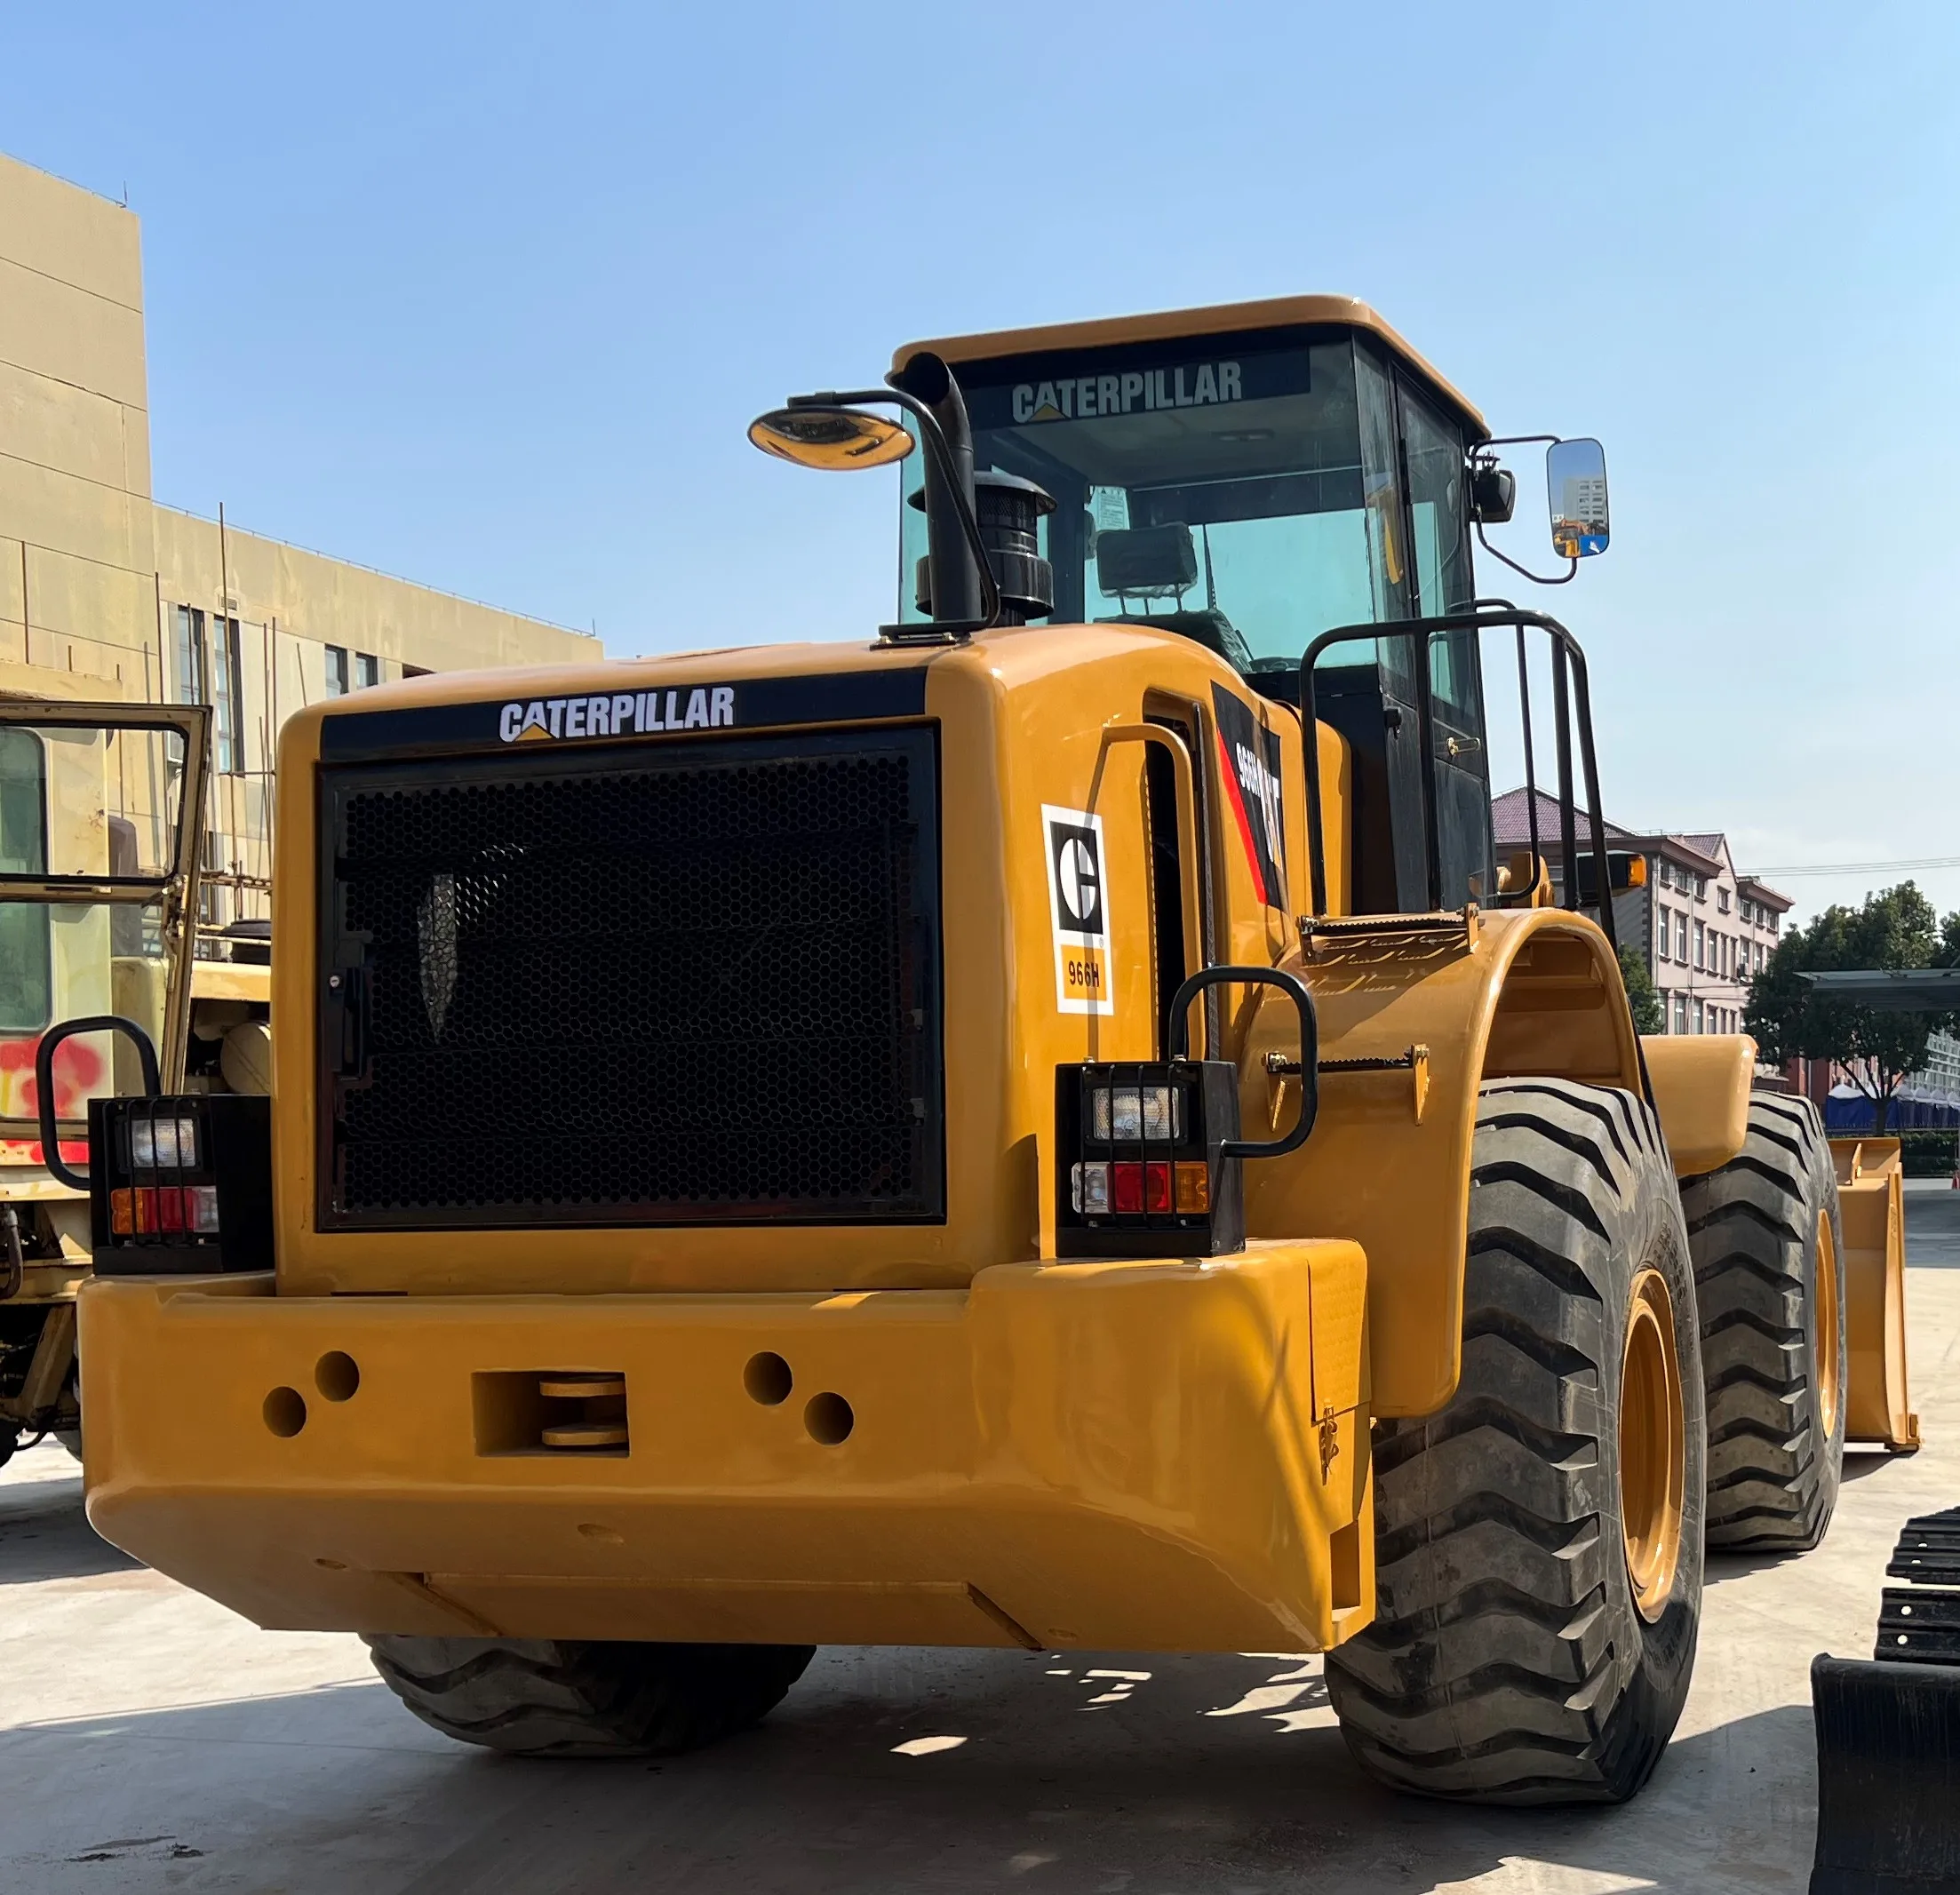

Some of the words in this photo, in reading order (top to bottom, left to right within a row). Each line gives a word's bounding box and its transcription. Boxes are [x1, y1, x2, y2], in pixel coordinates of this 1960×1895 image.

[1012, 362, 1241, 423] CATERPILLAR
[499, 687, 735, 743] CATERPILLAR
[1069, 960, 1100, 987] 966H
